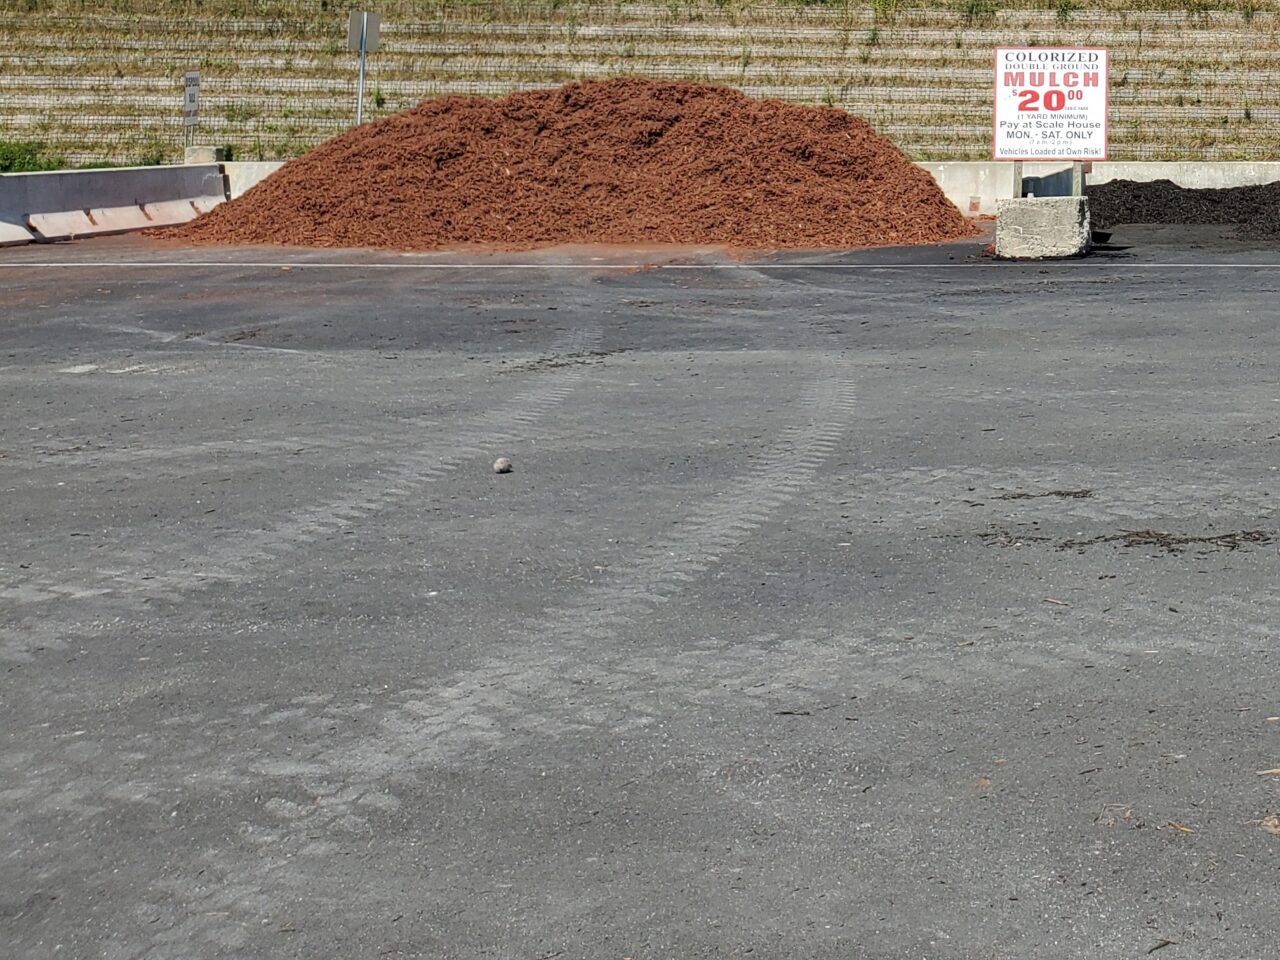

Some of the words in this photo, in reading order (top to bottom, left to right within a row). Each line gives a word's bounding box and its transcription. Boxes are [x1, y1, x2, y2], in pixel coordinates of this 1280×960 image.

[1005, 52, 1099, 62] COLORIZED
[1004, 71, 1099, 87] MULCH
[1000, 120, 1019, 130] Pay
[1035, 120, 1064, 128] Scale
[1067, 120, 1101, 128] House
[1006, 130, 1033, 139] MON.
[1041, 130, 1063, 139] SAT.
[1065, 130, 1093, 139] ONLY
[1000, 147, 1028, 155] Vehicles
[1030, 147, 1056, 155] Loaded
[1066, 147, 1082, 155] Own
[1083, 147, 1101, 155] Risk!
